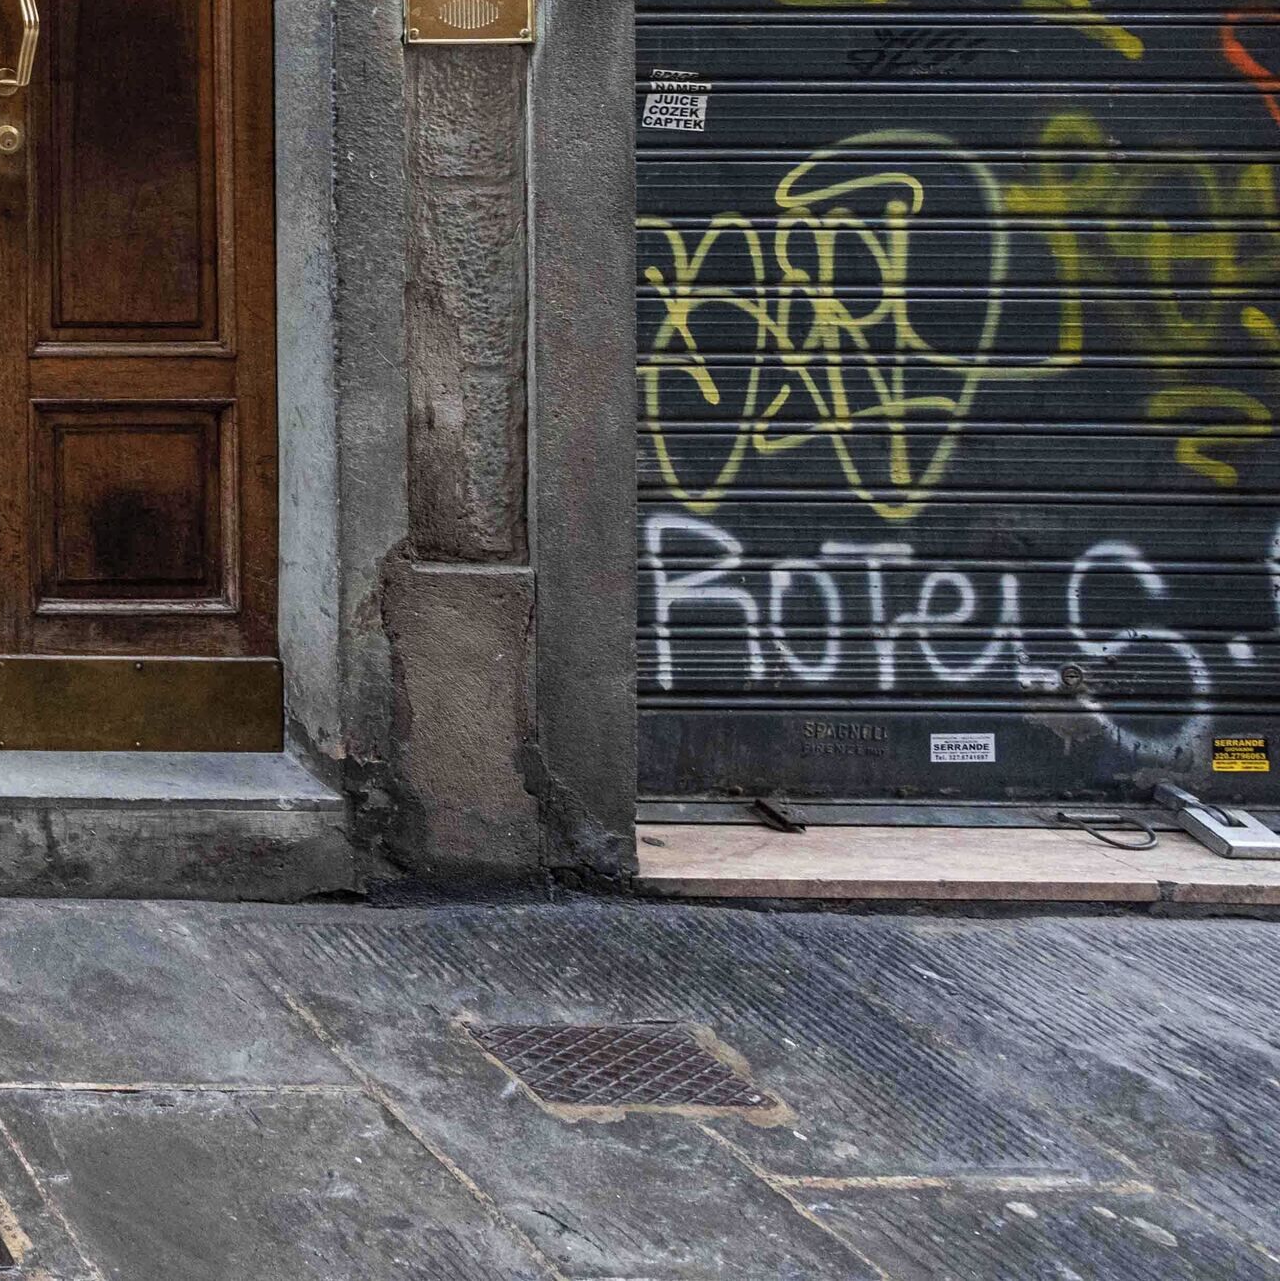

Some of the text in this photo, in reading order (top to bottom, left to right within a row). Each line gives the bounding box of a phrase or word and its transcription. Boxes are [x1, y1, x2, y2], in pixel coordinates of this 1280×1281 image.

[654, 95, 699, 107] JUICE
[648, 105, 700, 118] COZEK
[643, 115, 705, 129] CAPTEK
[933, 743, 990, 751] SERRANDE
[1215, 739, 1265, 747] SERRANDE
